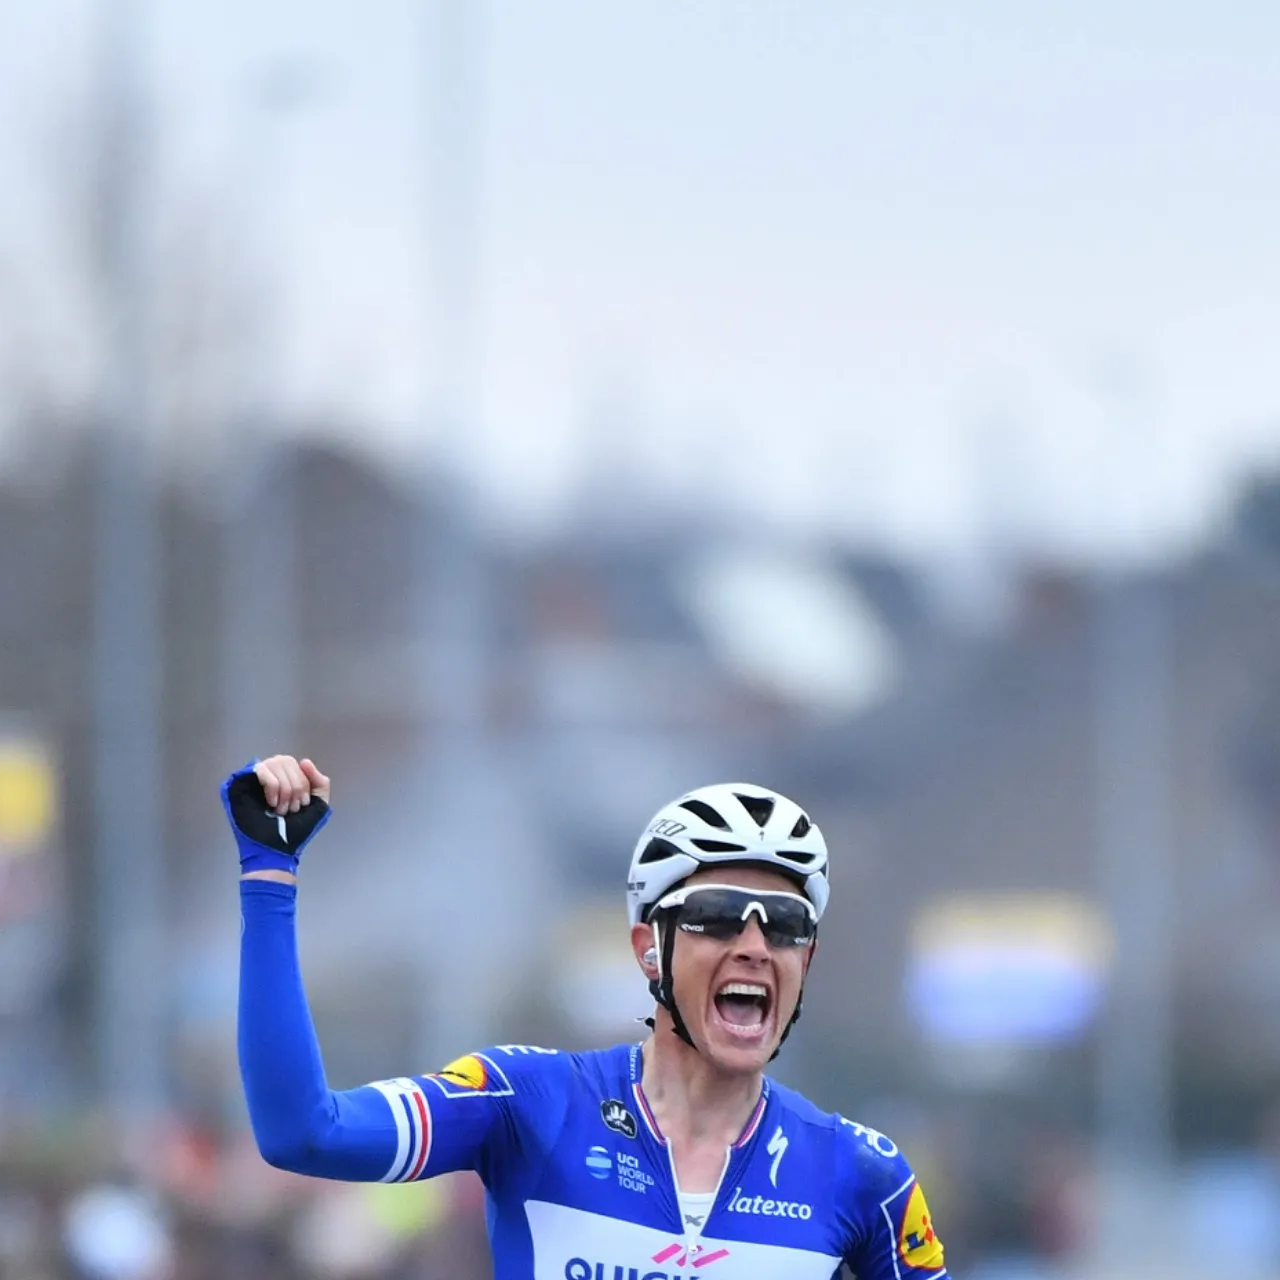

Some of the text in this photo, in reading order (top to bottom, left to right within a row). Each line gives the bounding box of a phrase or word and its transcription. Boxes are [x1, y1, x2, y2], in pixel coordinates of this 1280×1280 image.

[617, 1153, 639, 1168] UCI
[617, 1165, 654, 1186] WORLD
[618, 1176, 646, 1194] TOUR
[727, 1187, 812, 1220] latexco
